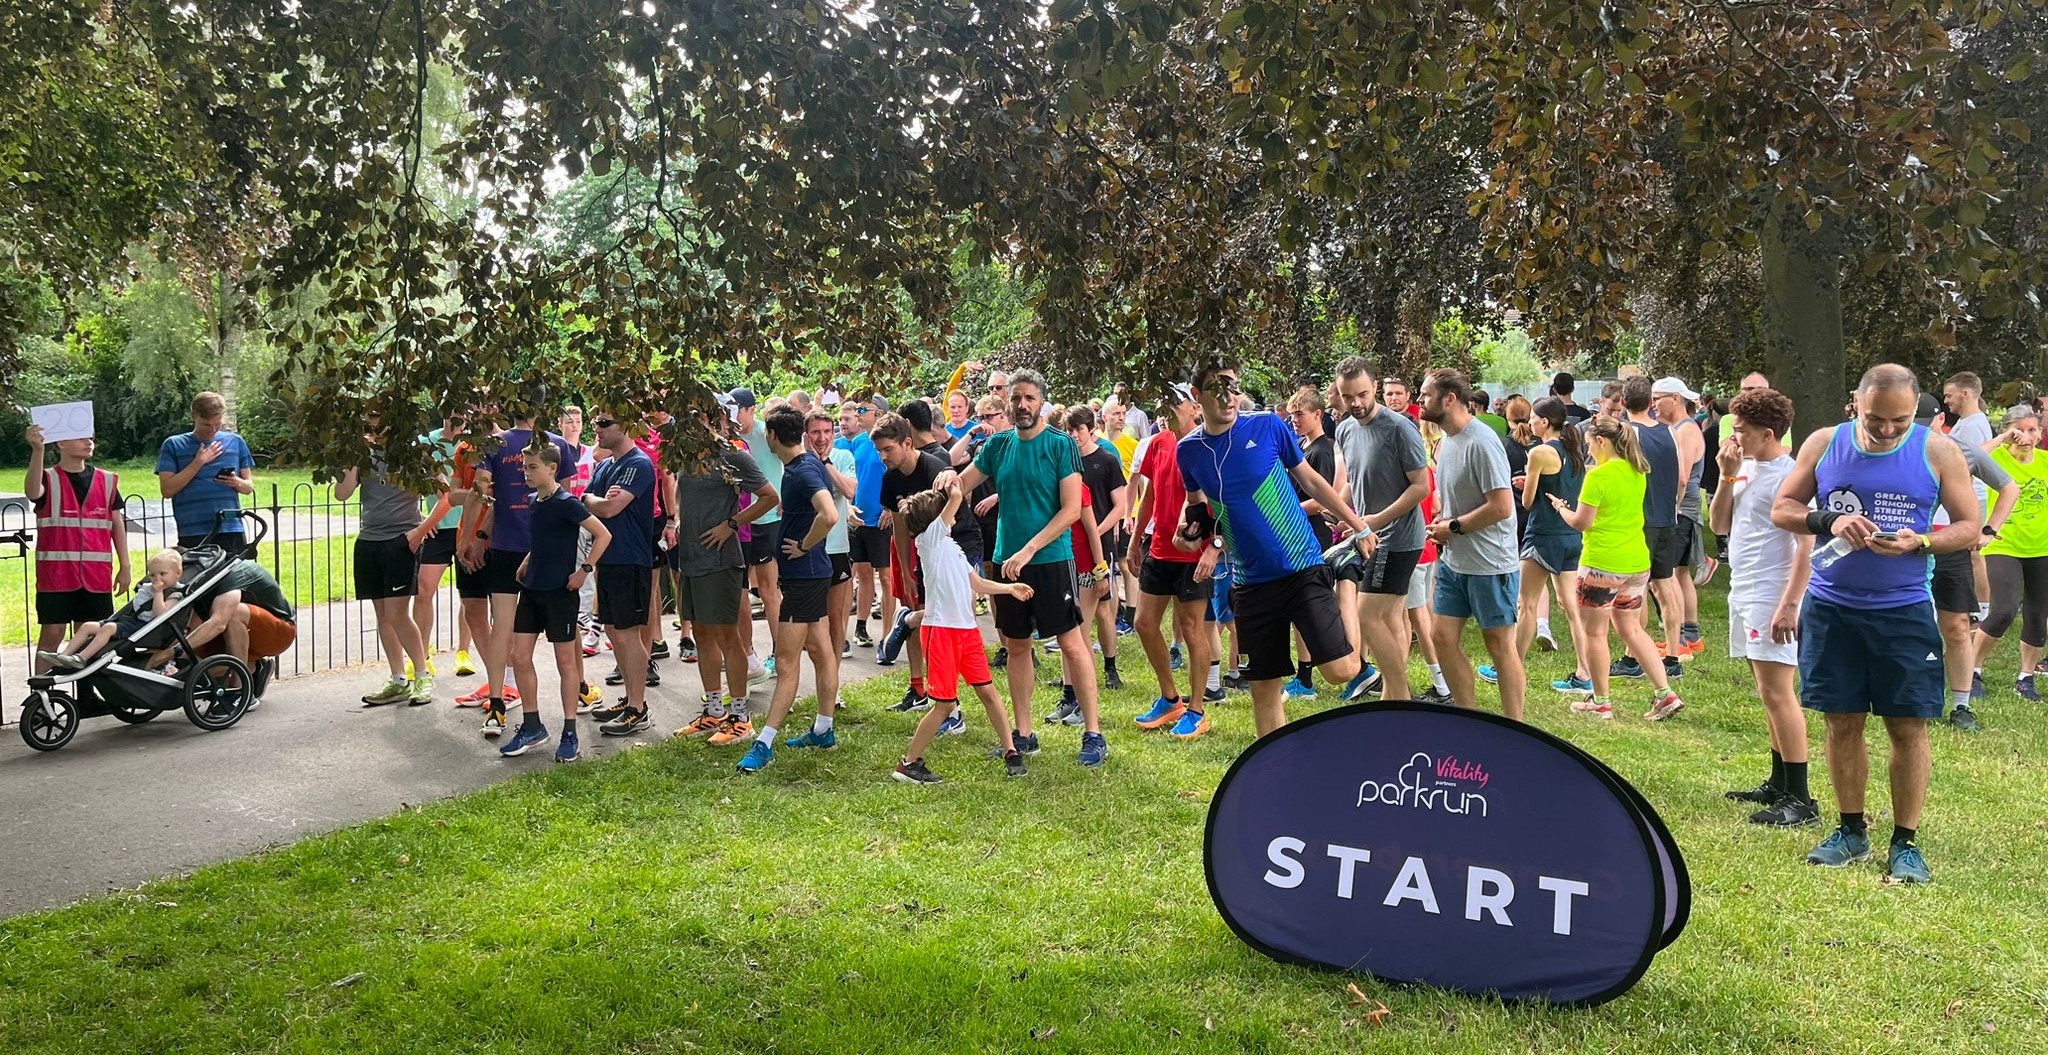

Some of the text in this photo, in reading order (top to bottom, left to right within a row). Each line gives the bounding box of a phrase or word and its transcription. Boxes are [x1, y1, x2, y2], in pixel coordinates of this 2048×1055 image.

[43, 406, 91, 435] 20
[1874, 492, 1907, 501] GREAT
[1874, 499, 1917, 509] ORMOND
[1873, 514, 1916, 524] HOSPITAL
[1874, 507, 1907, 516] STREET
[1436, 755, 1489, 789] Vitality
[1357, 771, 1487, 817] parkrun
[1263, 836, 1589, 936] START
